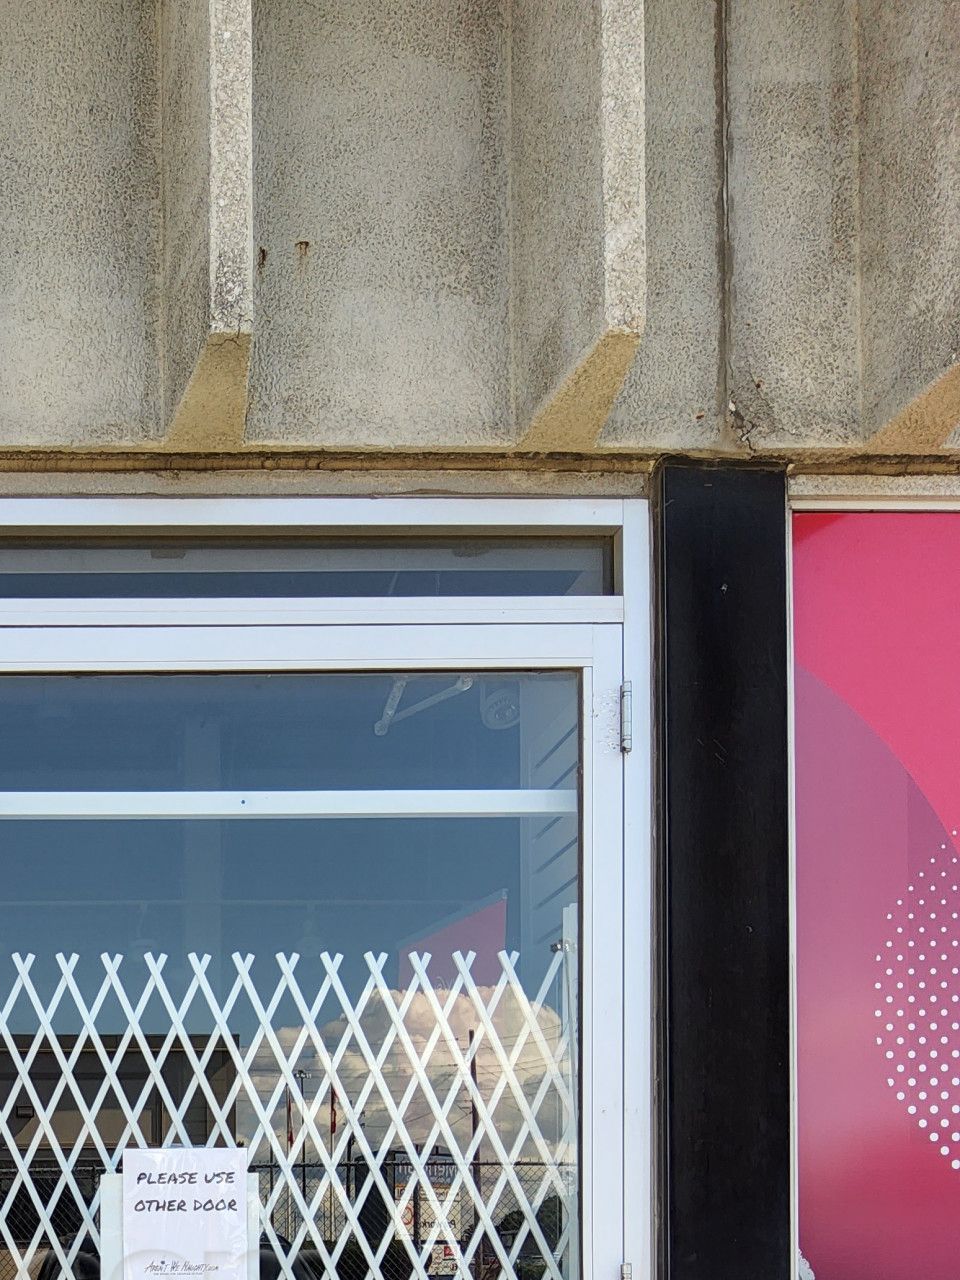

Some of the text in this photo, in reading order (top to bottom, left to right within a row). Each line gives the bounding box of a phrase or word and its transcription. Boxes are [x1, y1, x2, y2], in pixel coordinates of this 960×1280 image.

[136, 1171, 236, 1185] PLEASE USE
[134, 1198, 238, 1212] OTHER DOOR
